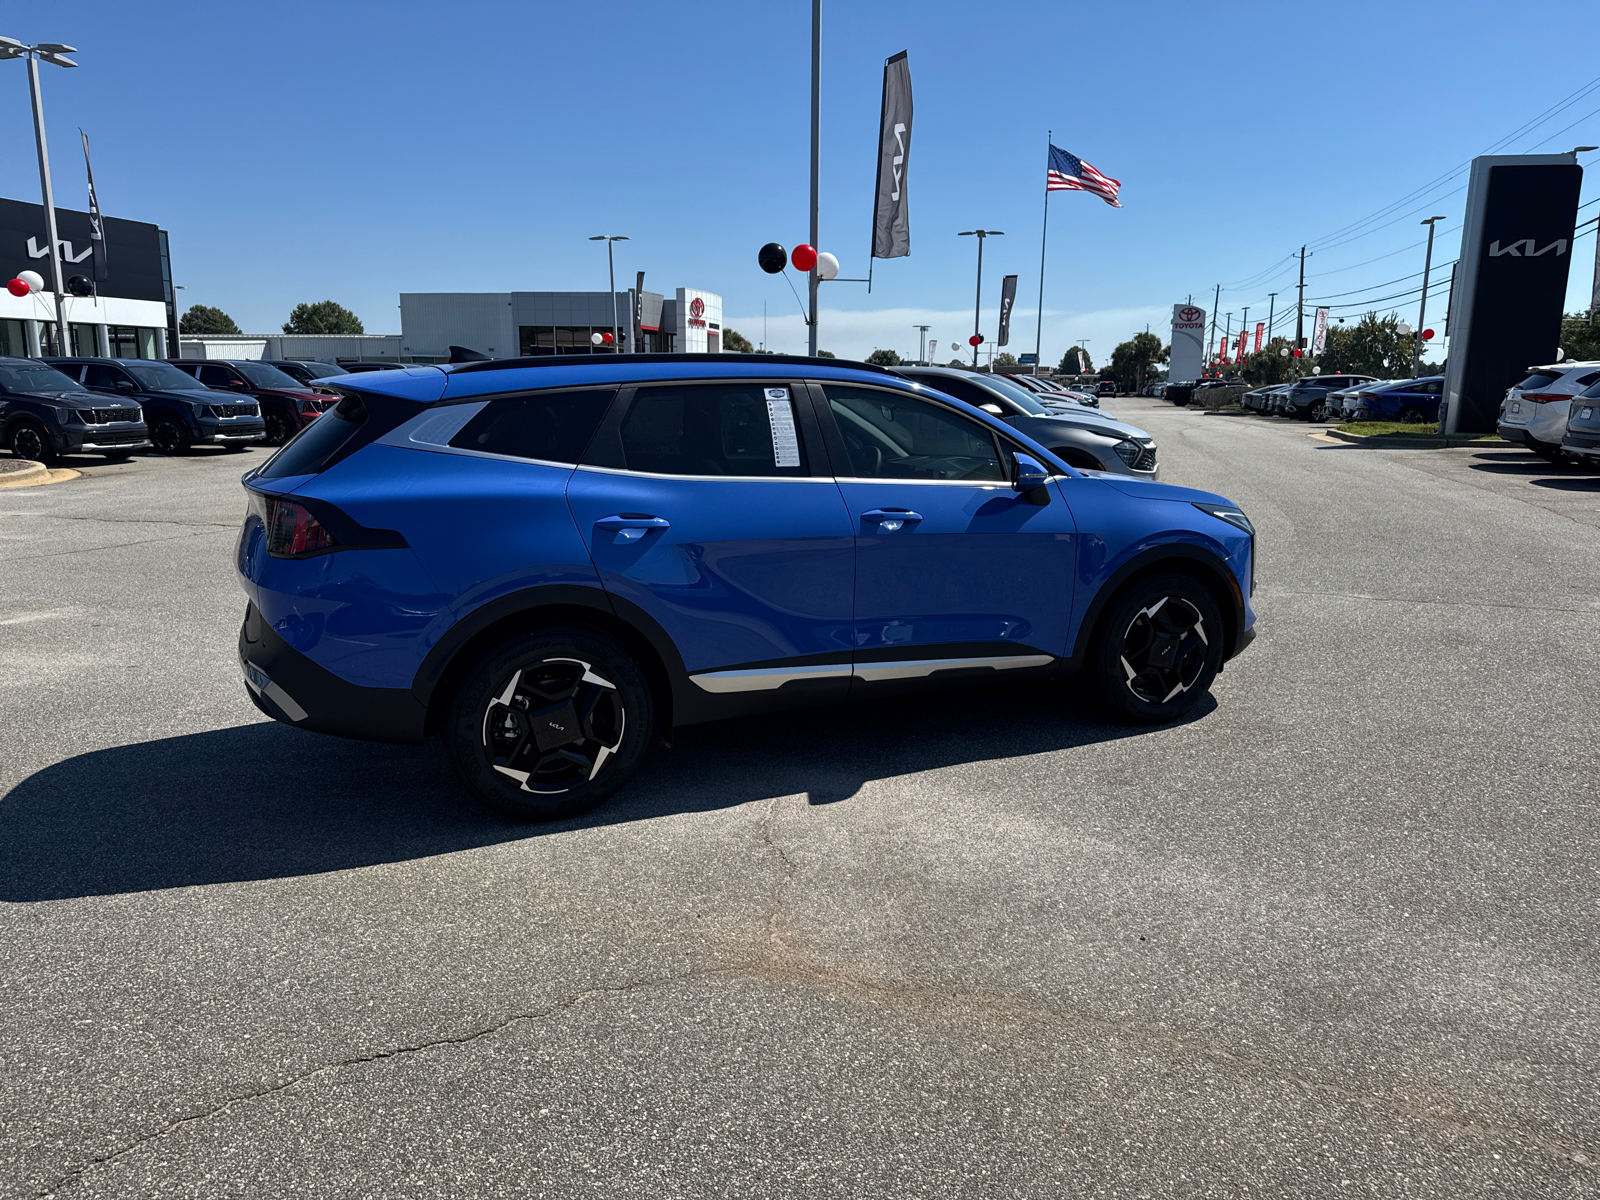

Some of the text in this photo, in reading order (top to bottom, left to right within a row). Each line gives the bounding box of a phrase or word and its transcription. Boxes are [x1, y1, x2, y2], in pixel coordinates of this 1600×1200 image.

[891, 122, 906, 201] KIA
[1488, 238, 1568, 257] KIA
[494, 640, 551, 672] CRUGEN
[549, 721, 565, 731] KIA
